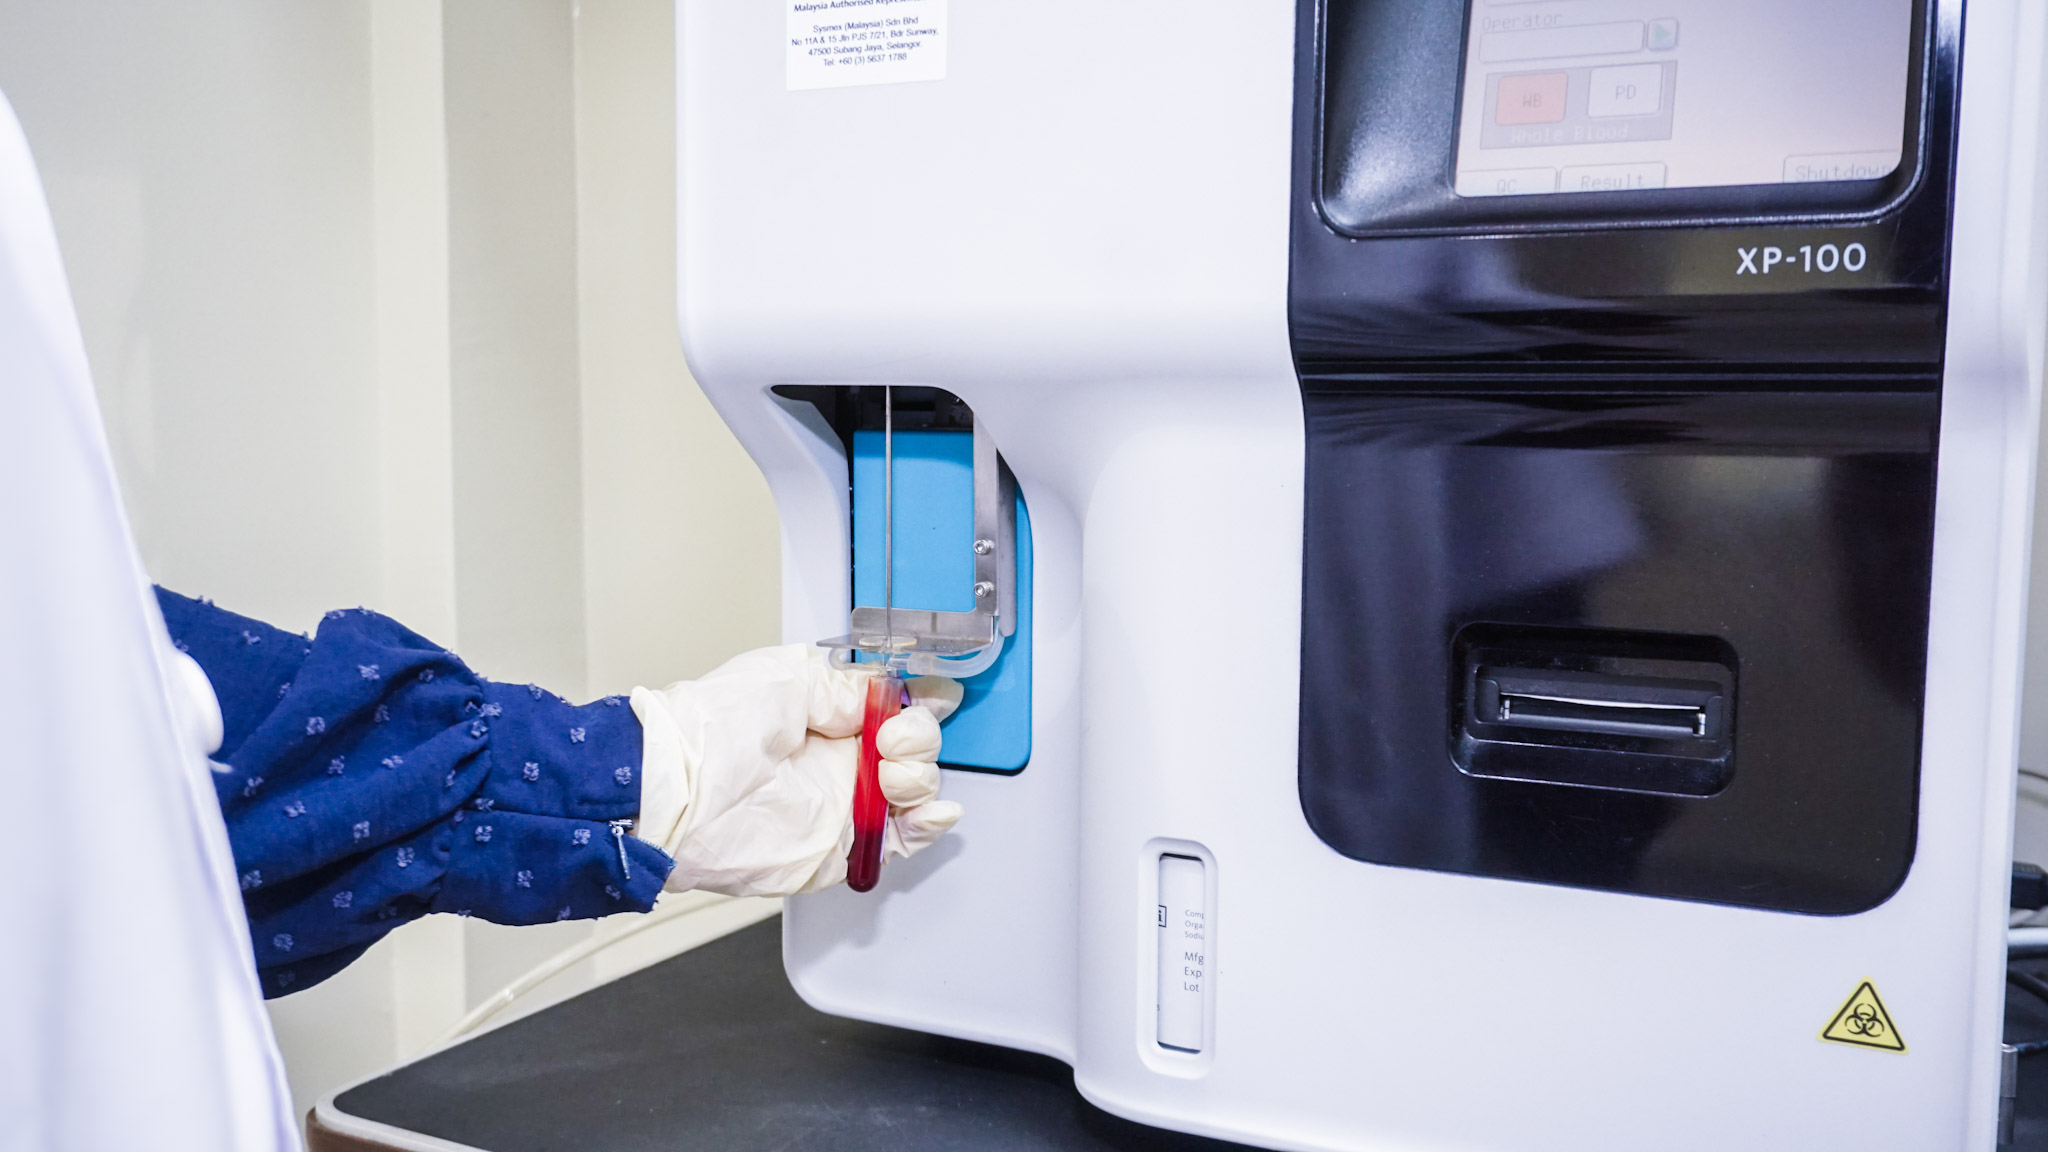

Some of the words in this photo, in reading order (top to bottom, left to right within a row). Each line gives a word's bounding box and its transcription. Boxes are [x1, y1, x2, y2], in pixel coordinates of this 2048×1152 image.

[794, 3, 828, 13] Malaysia
[830, 0, 874, 9] Authorised
[813, 24, 842, 34] Sysmex
[844, 20, 883, 32] (Malaysia)
[885, 18, 901, 27] Sdn
[903, 16, 919, 25] Bhd
[1481, 13, 1563, 31] Operator
[791, 38, 803, 46] No
[805, 37, 818, 46] 11A
[819, 36, 826, 44] &
[828, 35, 837, 43] 15
[839, 34, 850, 42] Jln
[851, 32, 868, 41] PJS
[890, 30, 904, 38] Bdr
[808, 47, 832, 56] 47500
[833, 45, 862, 55] Subang
[838, 56, 853, 65] +60
[854, 56, 865, 66] (3)
[867, 54, 886, 63] 5637
[888, 52, 907, 61] 1788
[1521, 93, 1543, 109] WB
[1614, 84, 1637, 100] PD
[1510, 127, 1565, 145] Whole
[1574, 123, 1630, 141] Blood
[1496, 179, 1518, 194] QC
[1580, 173, 1645, 191] Result
[1735, 243, 1867, 275] XP-100
[1184, 951, 1204, 965] Mfg
[1184, 966, 1202, 979] Exp
[1184, 981, 1200, 993] Lot
